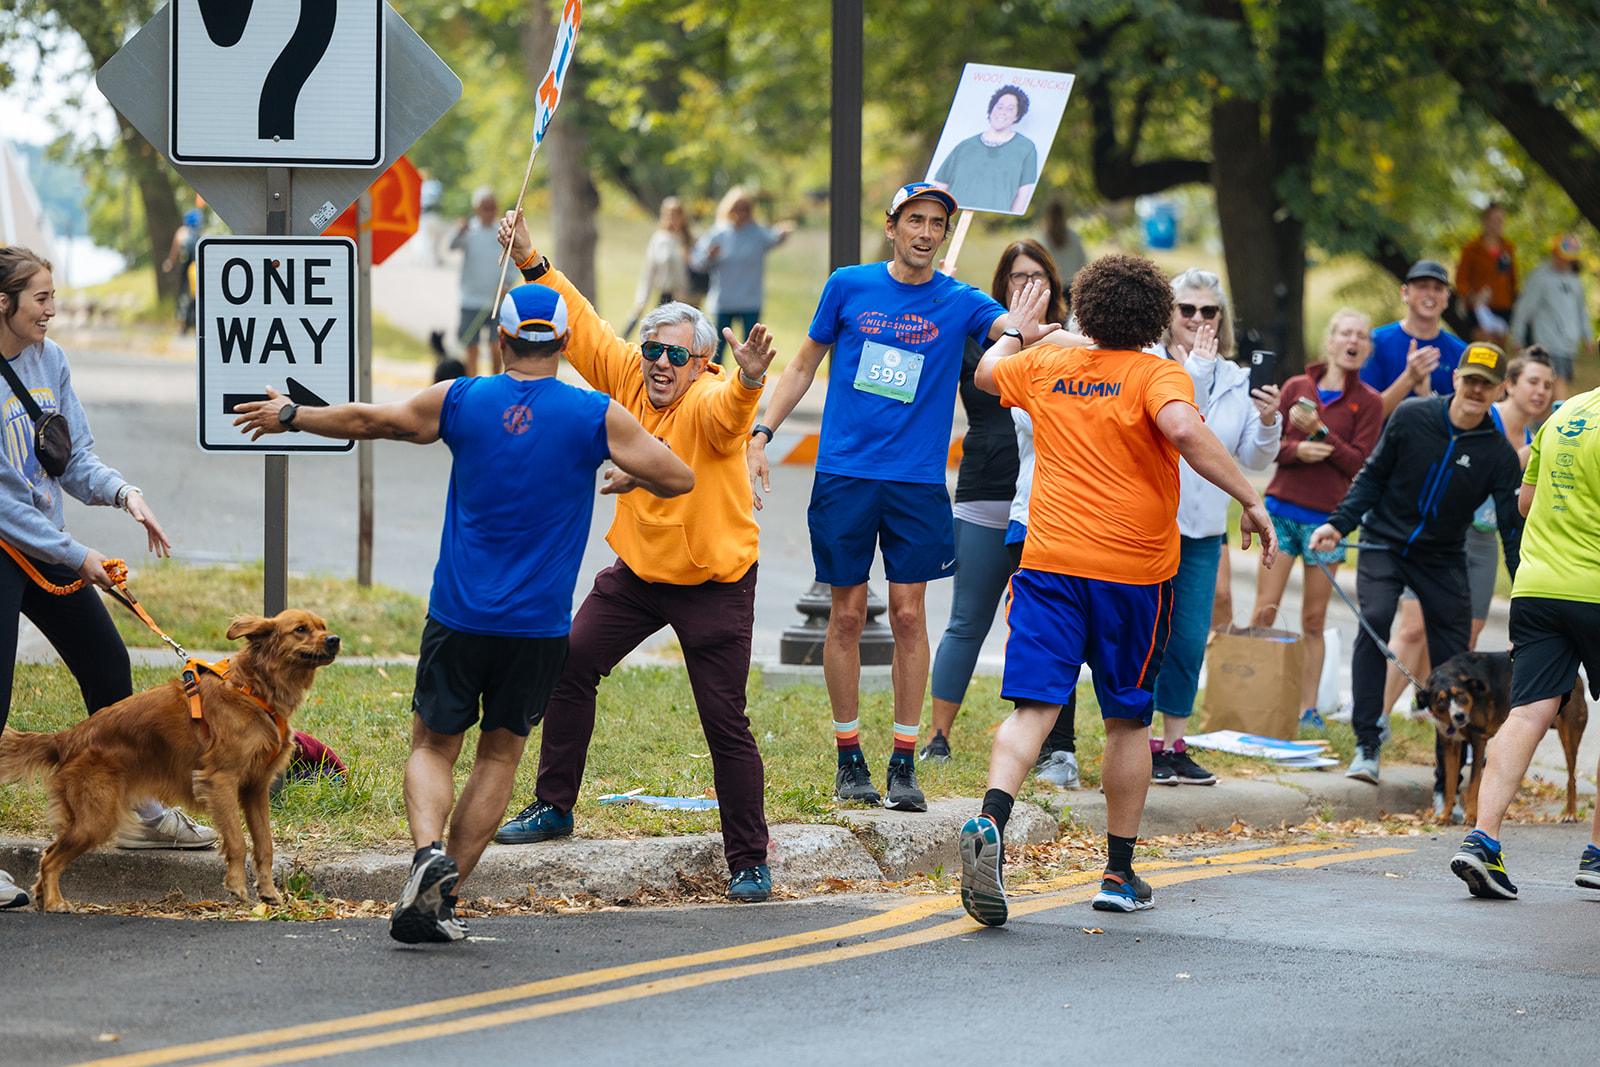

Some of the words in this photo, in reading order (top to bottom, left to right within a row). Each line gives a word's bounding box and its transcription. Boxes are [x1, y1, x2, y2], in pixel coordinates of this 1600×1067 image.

[221, 257, 333, 305] ONE
[865, 318, 887, 328] MILE
[893, 322, 922, 331] SHOES
[216, 317, 338, 364] WAY
[867, 364, 907, 386] 599
[1051, 378, 1121, 397] ALUMNI
